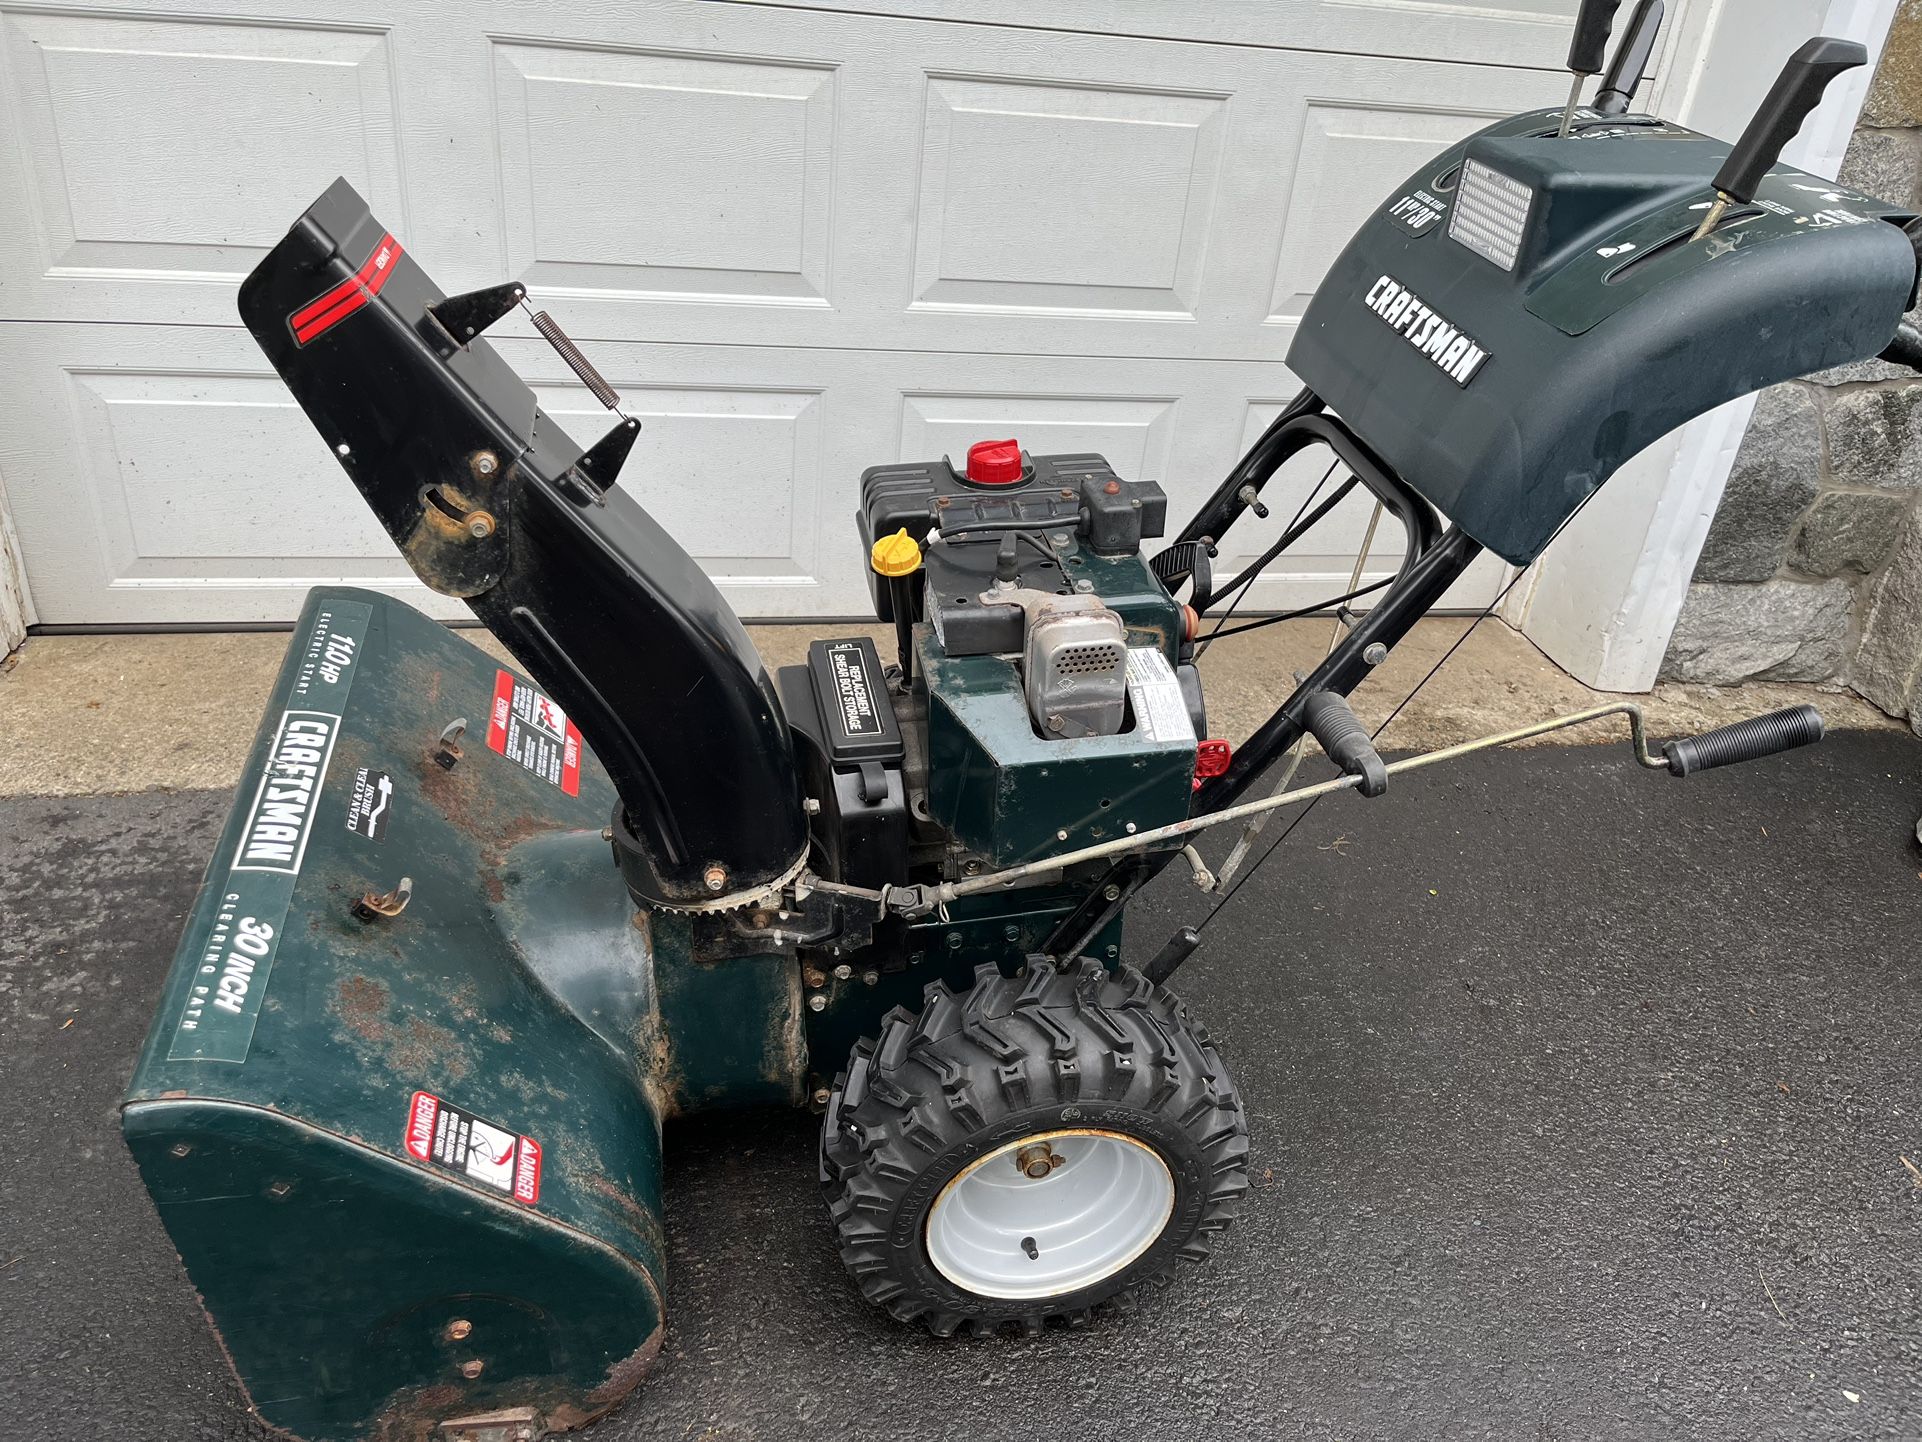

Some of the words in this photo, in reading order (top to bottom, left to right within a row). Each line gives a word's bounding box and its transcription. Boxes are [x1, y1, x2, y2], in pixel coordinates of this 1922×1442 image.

[1365, 276, 1484, 382] CRAFTSMAN
[309, 613, 331, 657] ELECTRIC
[297, 664, 315, 694] START
[834, 654, 849, 677] SHEAR
[840, 678, 853, 696] BOLT
[849, 666, 871, 716] REPLACEMENT
[844, 697, 861, 730] STORAGE
[1134, 689, 1152, 731] WARNING
[246, 721, 328, 861] CRAFTSMAN
[361, 784, 374, 816] BRUSH
[348, 800, 360, 830] CLEAN
[201, 894, 239, 972] CLEARING
[234, 917, 273, 955] 30
[214, 952, 255, 1013] INCH
[182, 987, 208, 1029] PATH
[414, 1095, 436, 1142] DANGER
[517, 1152, 536, 1200] DANGER
